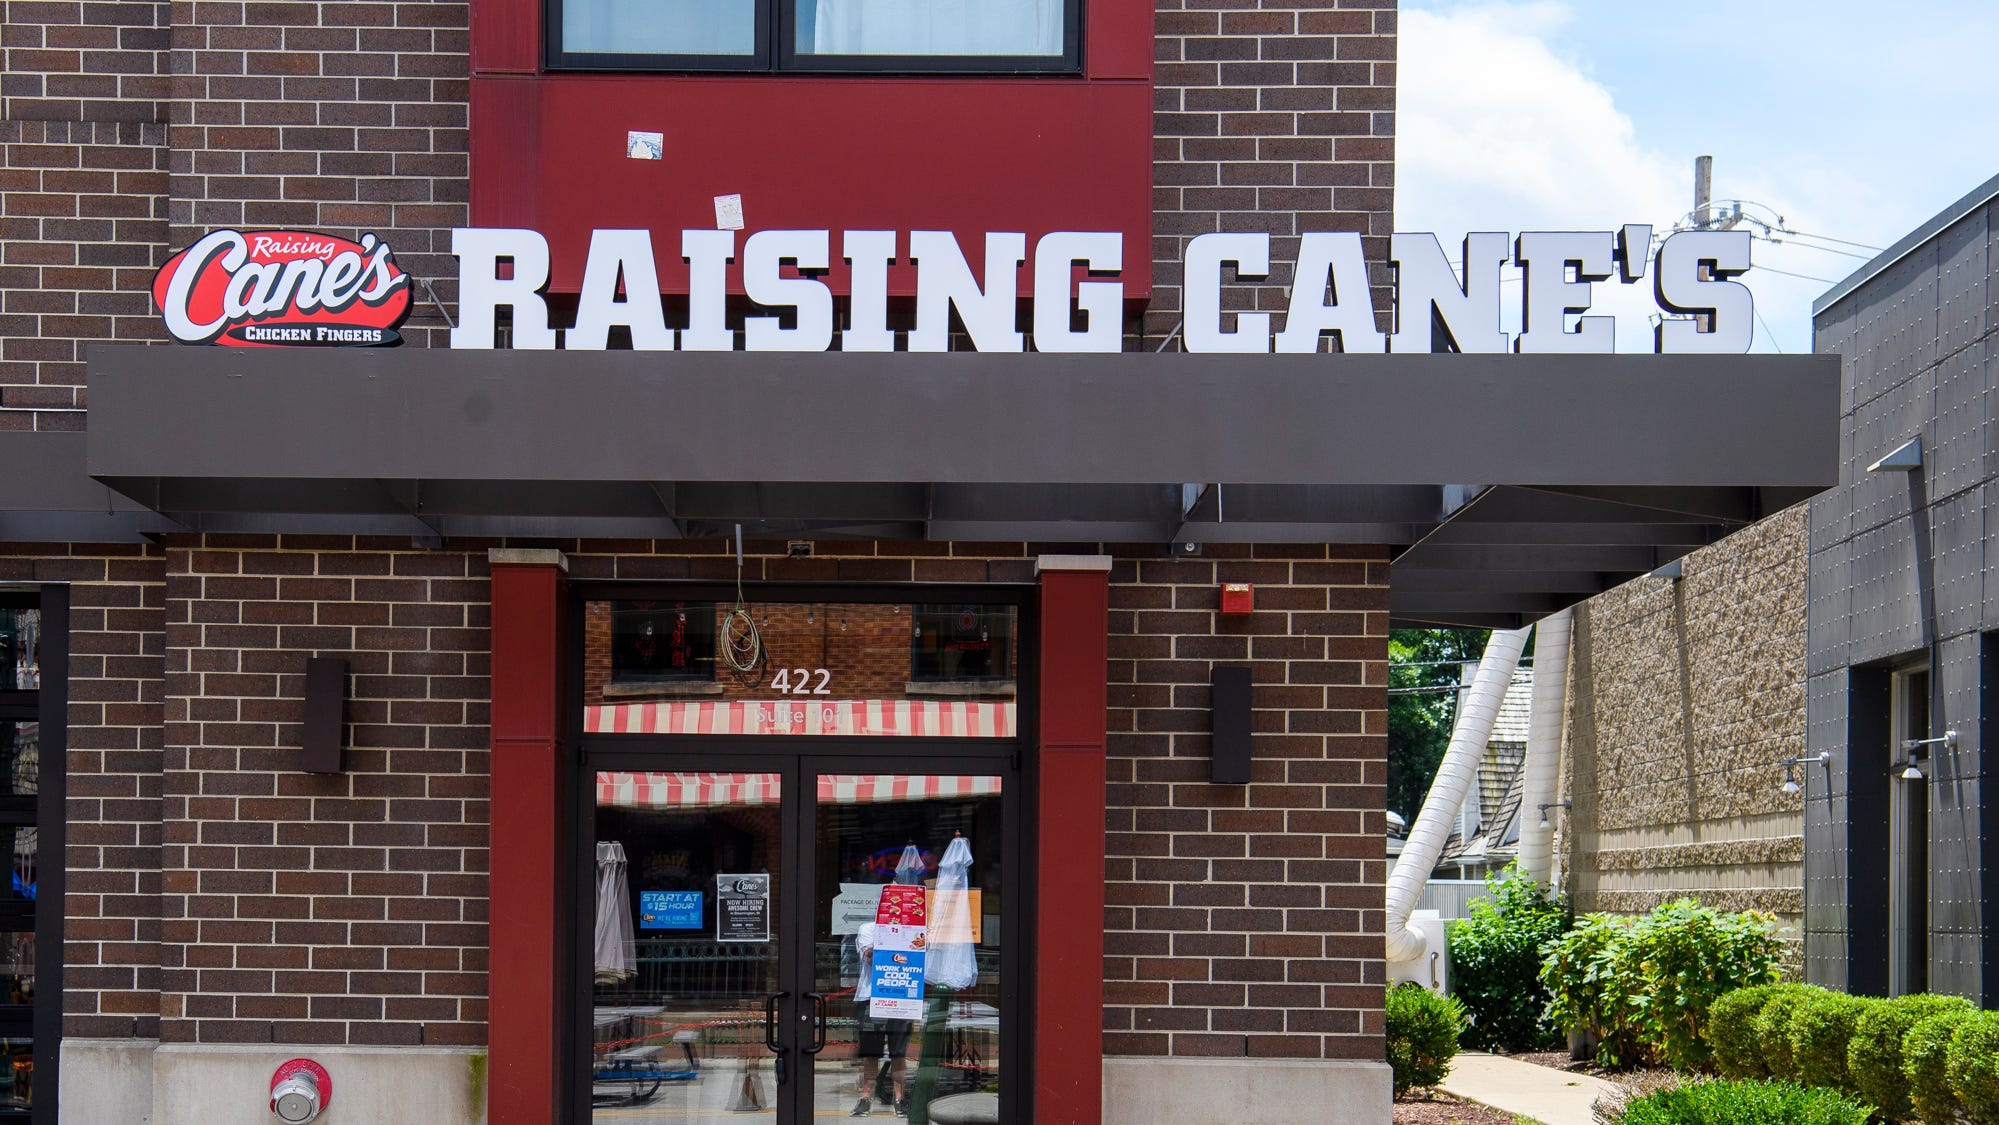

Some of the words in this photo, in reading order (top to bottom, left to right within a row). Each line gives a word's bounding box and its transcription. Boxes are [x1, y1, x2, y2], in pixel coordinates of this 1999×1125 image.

[252, 236, 336, 259] Raising
[164, 229, 407, 341] Cane's
[451, 227, 1123, 353] RAISING
[1184, 224, 1754, 354] CANE'S
[771, 668, 831, 694] 422
[757, 707, 804, 723] Suite
[812, 708, 843, 723] 101
[643, 894, 683, 902] START
[684, 894, 700, 902] AT
[875, 964, 900, 972] WORK
[884, 971, 912, 980] COOL
[876, 978, 920, 988] PEOPLE
